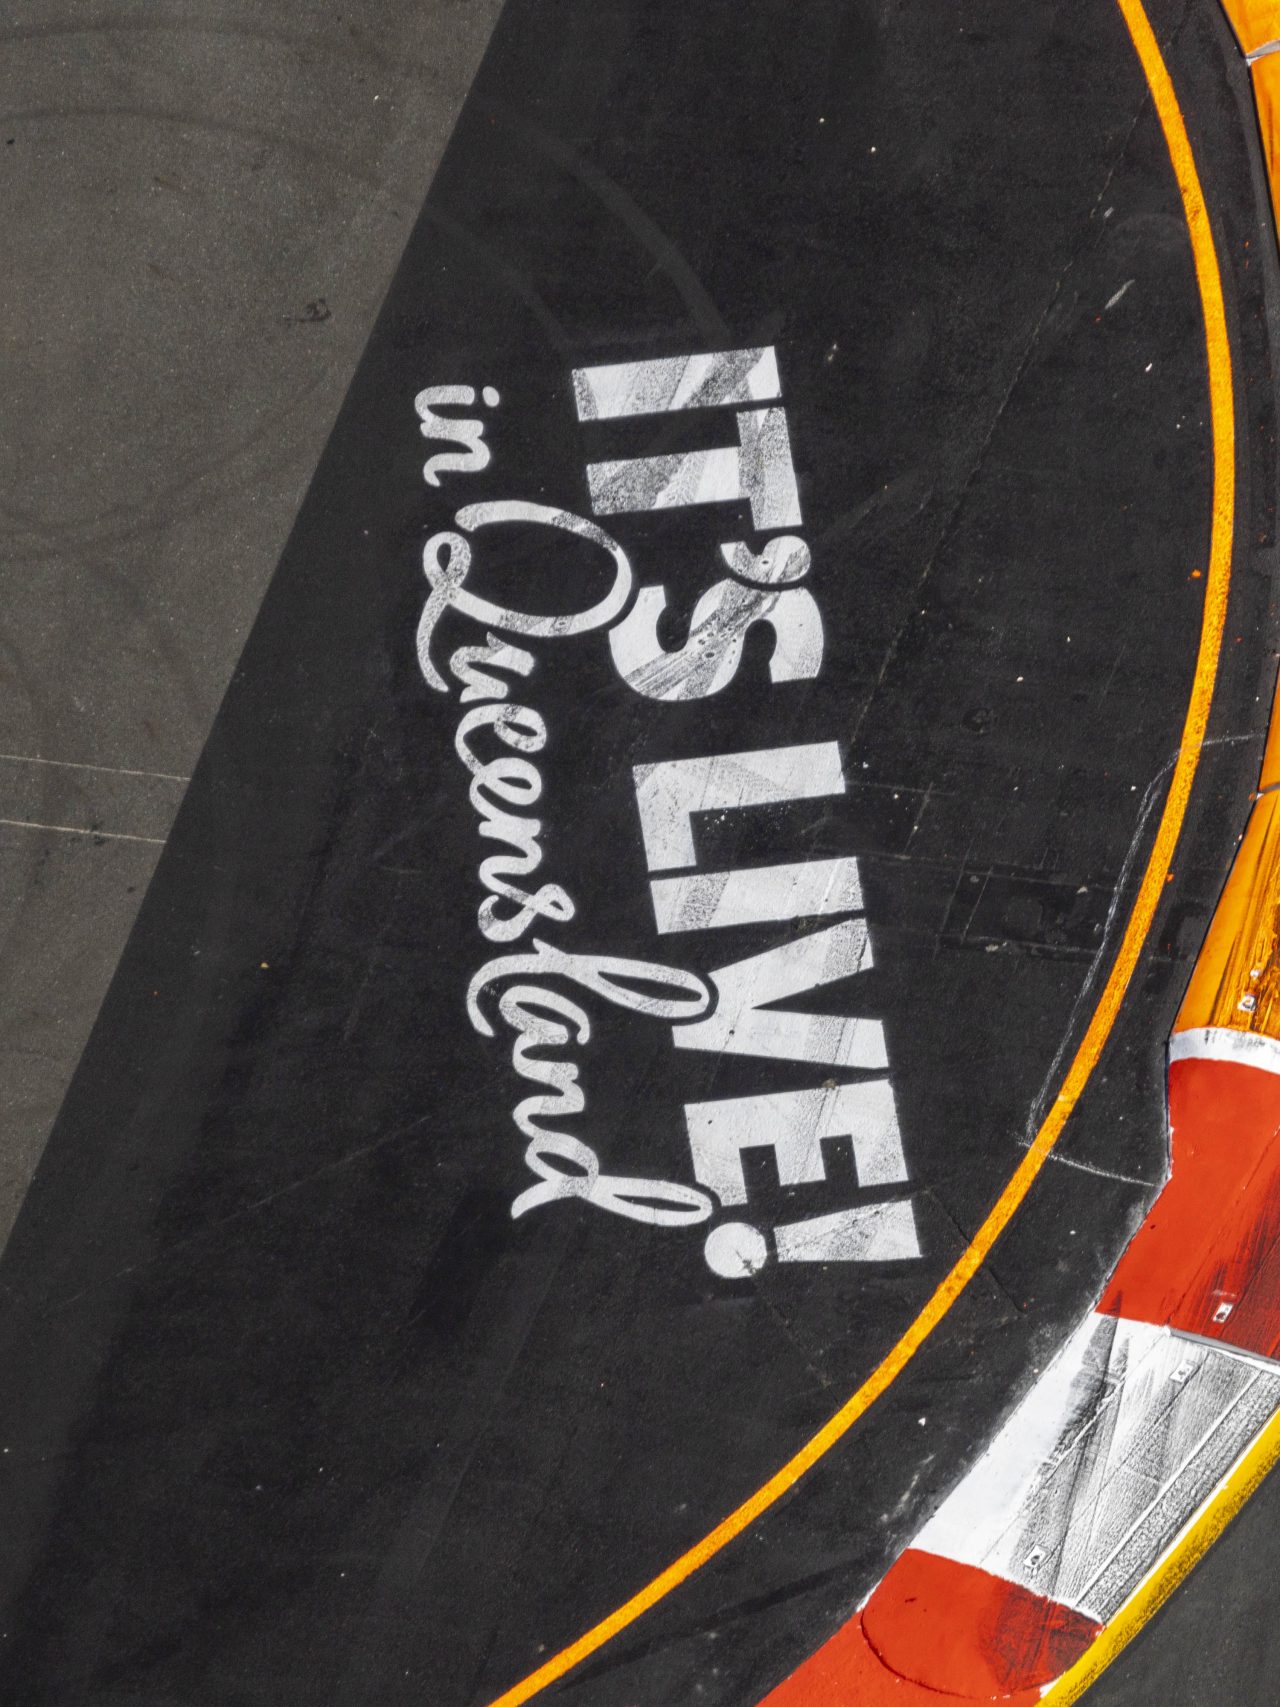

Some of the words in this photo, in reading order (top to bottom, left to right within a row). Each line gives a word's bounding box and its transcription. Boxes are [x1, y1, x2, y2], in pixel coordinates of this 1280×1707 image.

[414, 384, 500, 487] in
[571, 346, 824, 701] IT'S
[416, 500, 713, 1227] Queensland
[632, 741, 922, 1279] LIVE!
